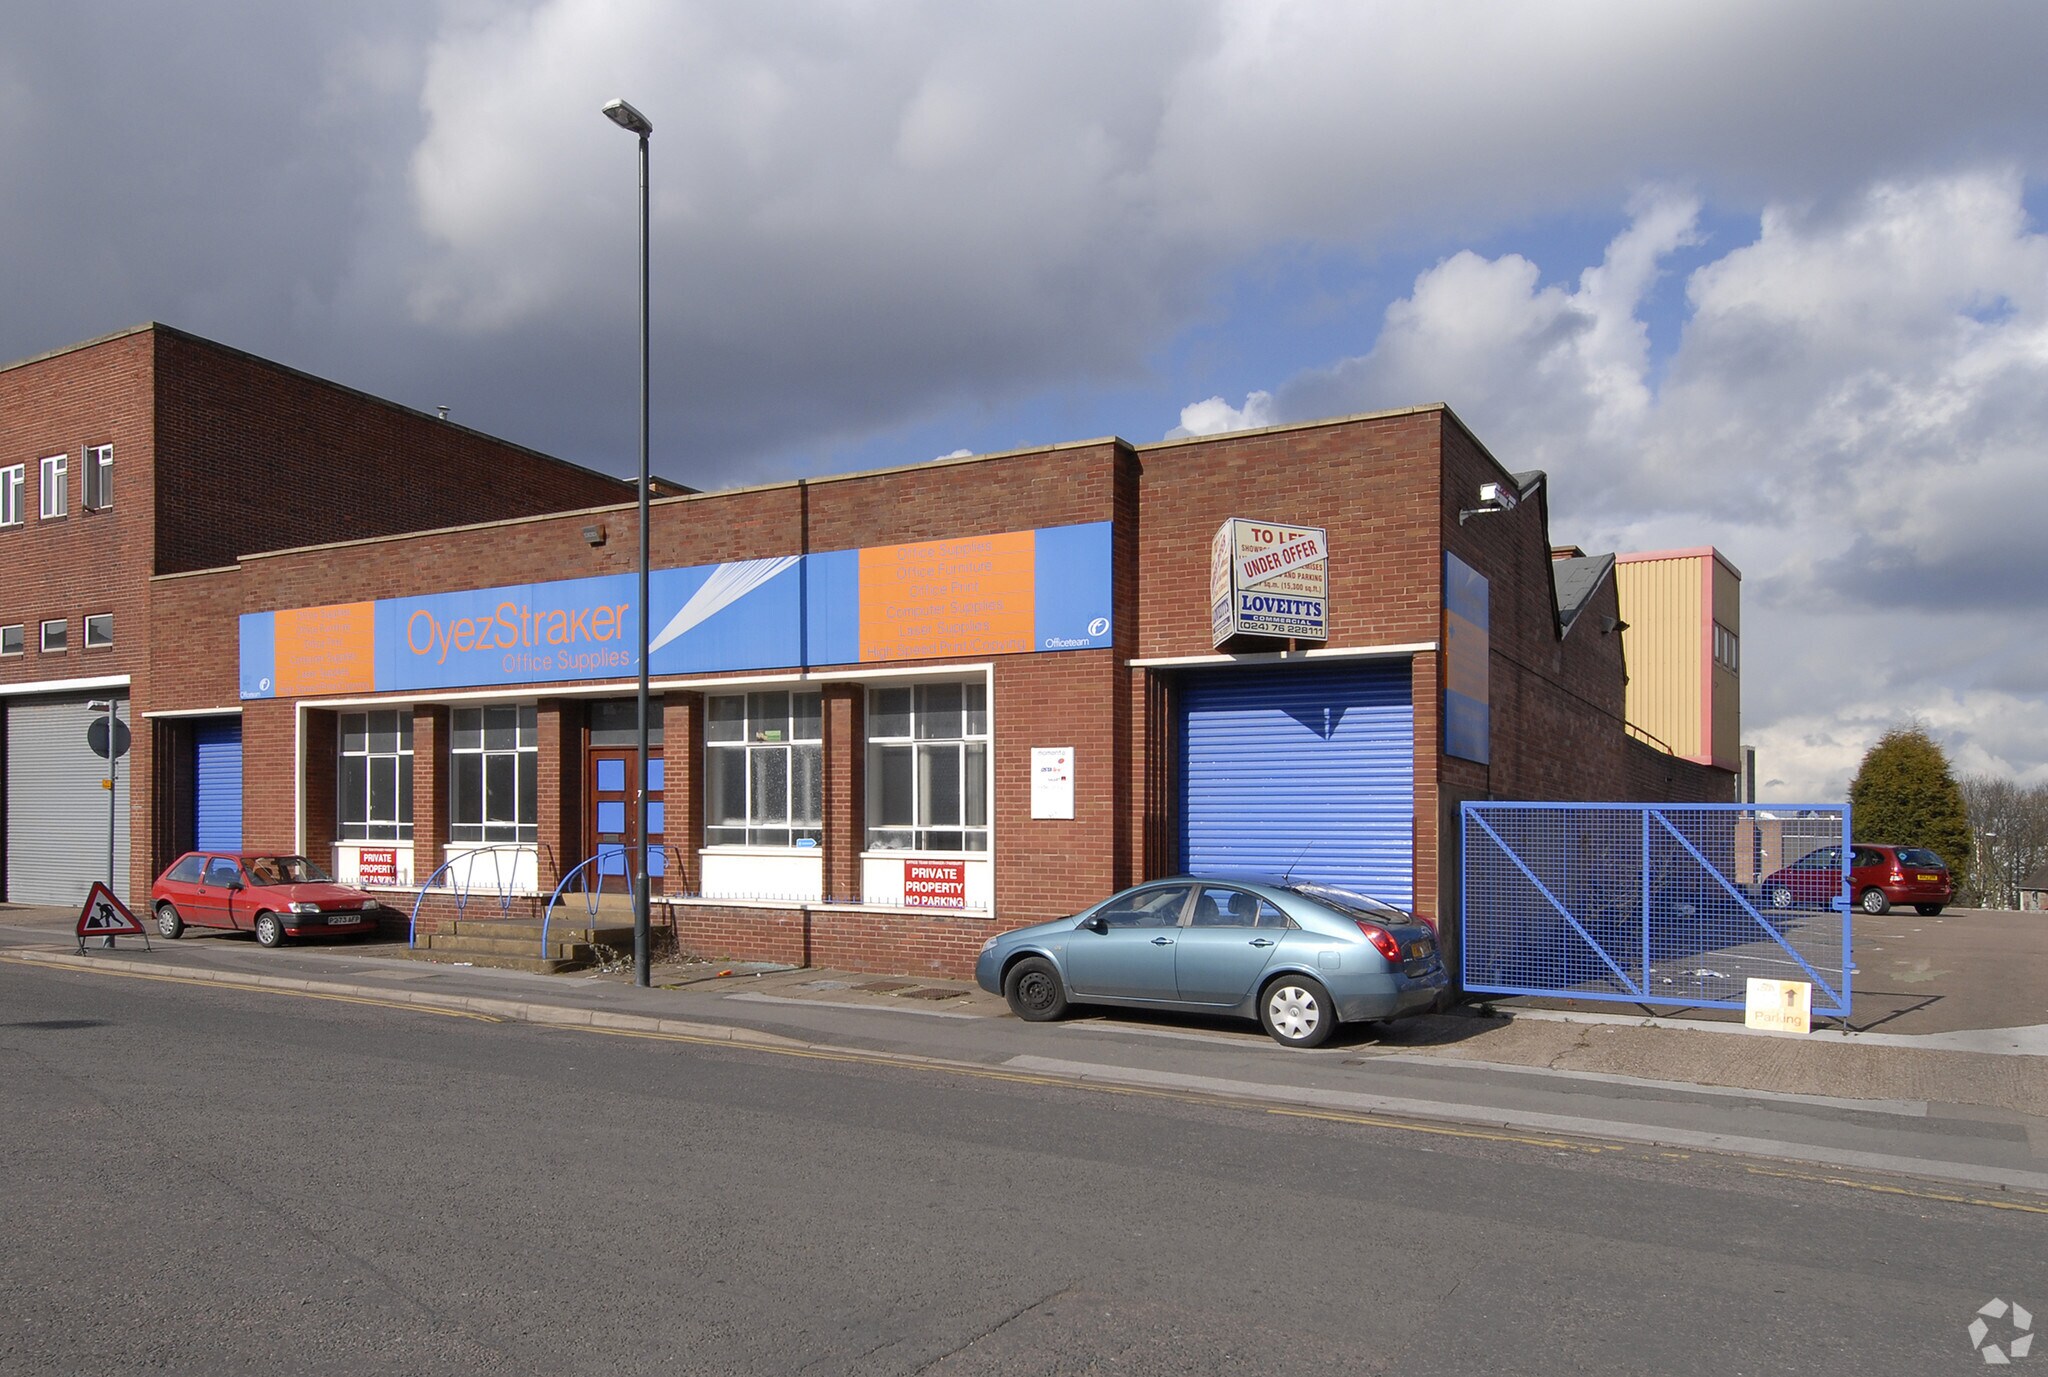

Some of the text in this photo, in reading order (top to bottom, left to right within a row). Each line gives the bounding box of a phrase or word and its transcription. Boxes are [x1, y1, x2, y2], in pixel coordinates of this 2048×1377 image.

[1251, 528, 1274, 544] TO
[1243, 539, 1318, 578] UNDER OFFER
[1297, 572, 1322, 582] PARKING
[1241, 595, 1322, 616] LOVEITTS
[1253, 615, 1311, 625] COMMERCIAL
[407, 602, 629, 665] OyezStraker
[1240, 621, 1323, 635] (024) 76 228111
[1045, 637, 1090, 649] Officeteam
[502, 648, 630, 673] Office Supplies
[363, 853, 392, 863] PRIVATE
[360, 864, 395, 873] PROPERTY
[911, 867, 957, 879] PRIVATE
[905, 881, 963, 893] PROPERTY
[905, 895, 963, 907] NO PARKING
